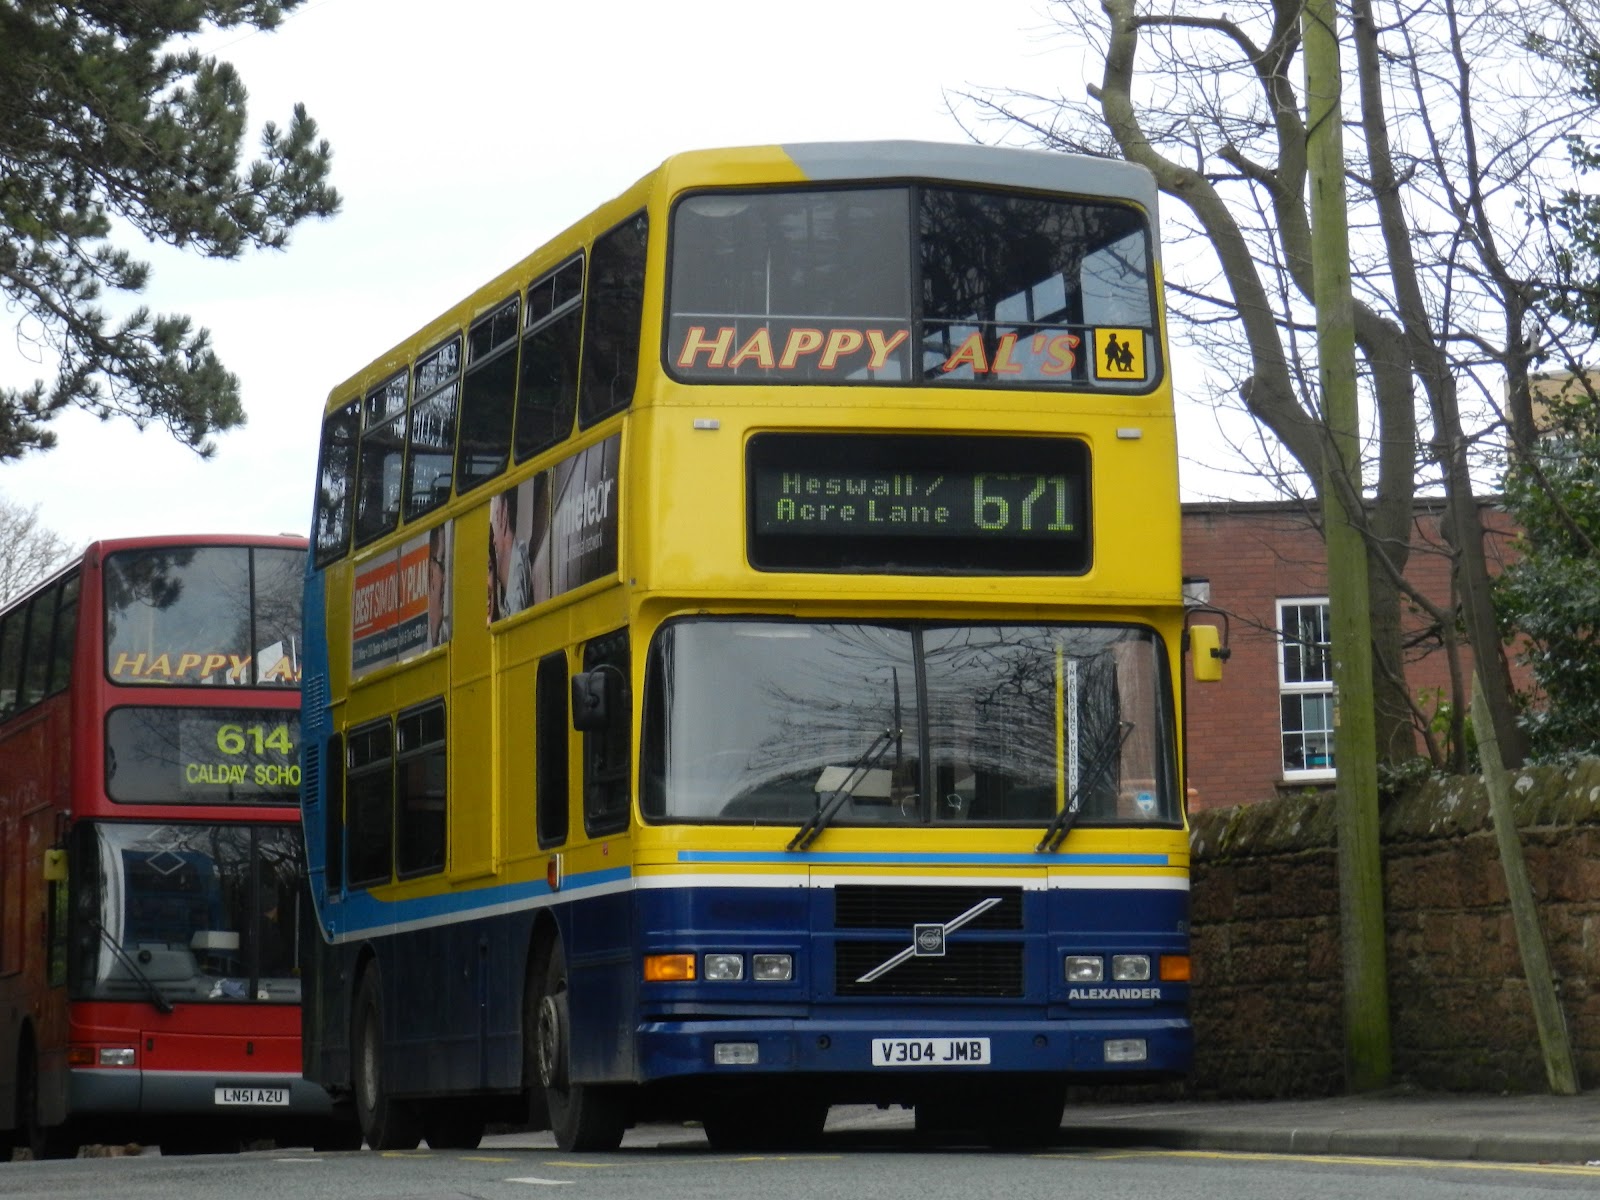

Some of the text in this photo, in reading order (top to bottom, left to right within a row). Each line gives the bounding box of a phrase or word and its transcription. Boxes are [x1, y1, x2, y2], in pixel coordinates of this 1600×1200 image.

[677, 326, 1080, 375] HAPPY AL'S
[782, 472, 913, 496] Heswall
[561, 480, 612, 535] meteor
[777, 498, 950, 523] Acre Lane
[974, 474, 1073, 531] 671
[354, 583, 375, 624] BEST
[408, 558, 429, 604] PLAN
[112, 652, 302, 681] HAPPY A
[216, 724, 293, 755] 614
[186, 763, 248, 784] CALDAY
[1070, 767, 1077, 781] TO
[1068, 988, 1161, 999] ALEXANDER
[882, 1041, 982, 1061] V304 JMB
[224, 1089, 283, 1103] LN51 AZU
